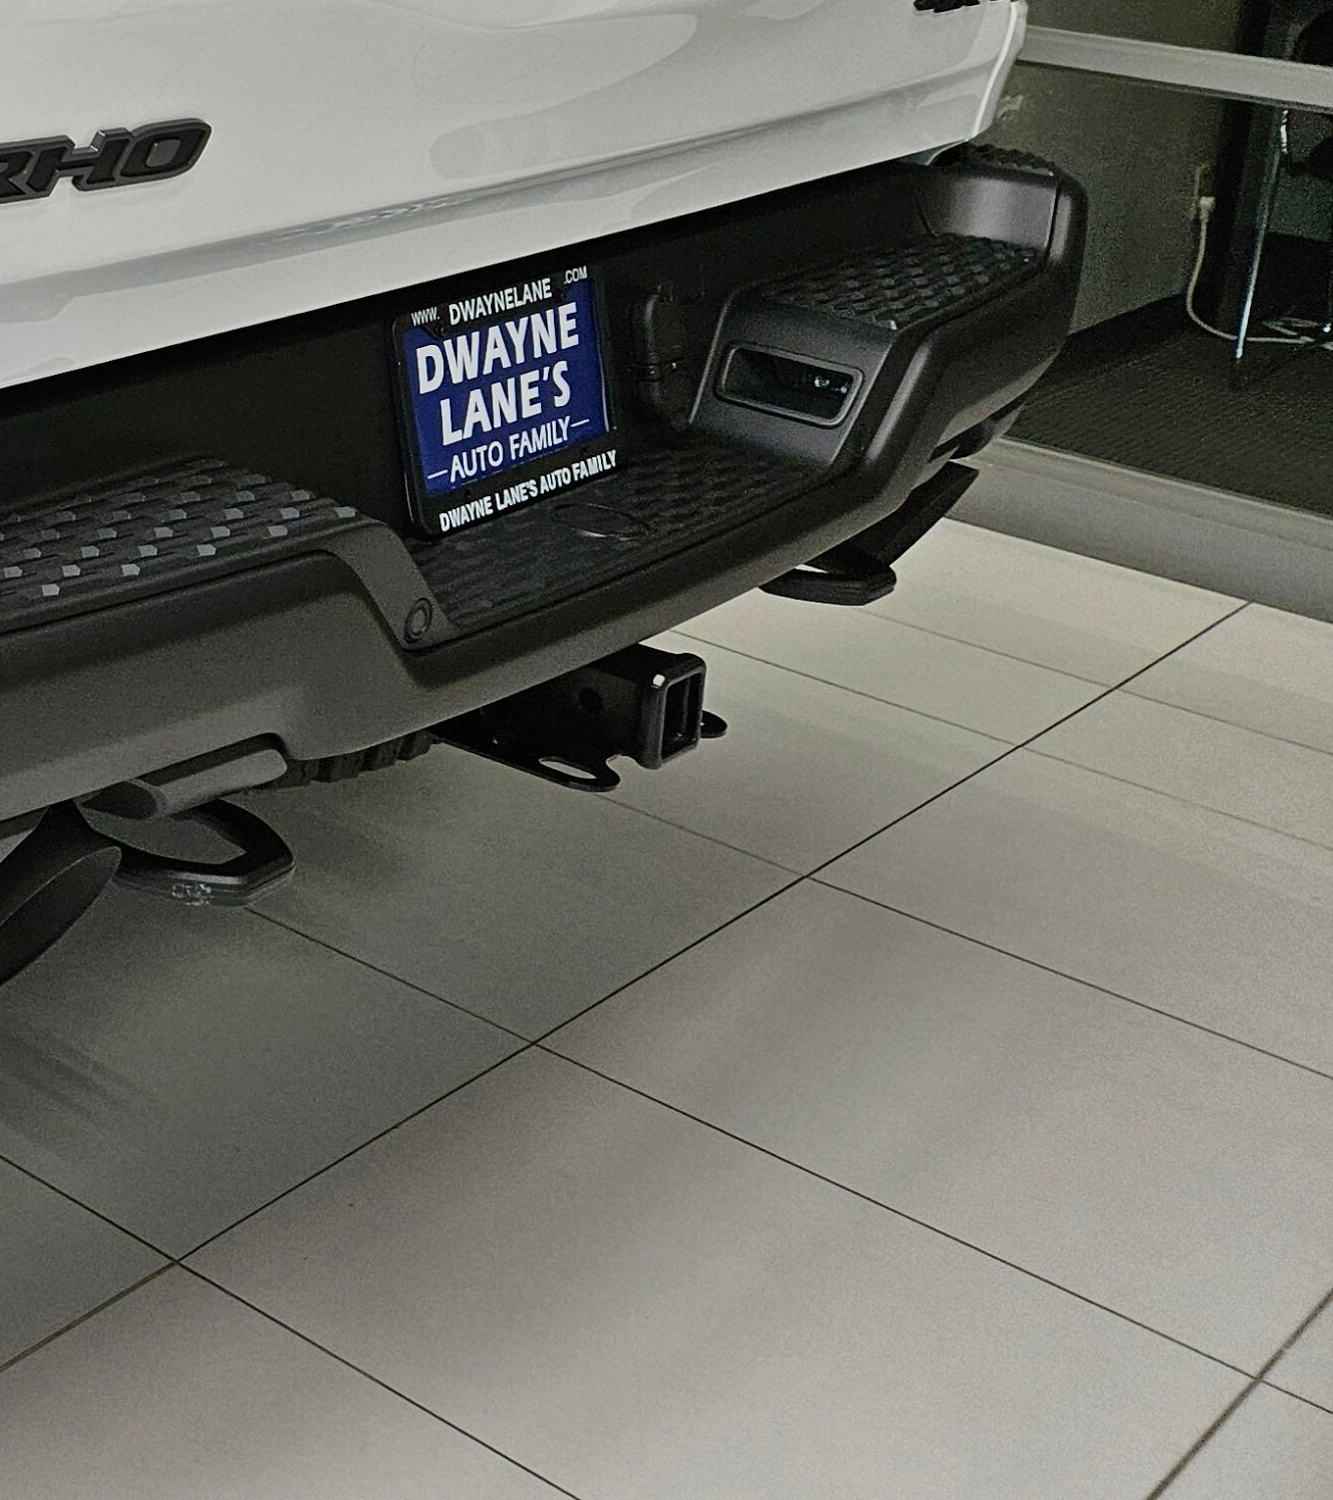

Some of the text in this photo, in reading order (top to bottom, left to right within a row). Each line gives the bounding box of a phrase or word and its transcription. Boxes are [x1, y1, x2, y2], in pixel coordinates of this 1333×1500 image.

[448, 277, 552, 326] DWAYNELANE
[415, 301, 580, 395] DWAYNE
[439, 360, 571, 446] LANE'S
[439, 449, 617, 533] DWAYNE LANE'S AUTO FAMILY
[449, 415, 572, 483] AUTO FAMILY
